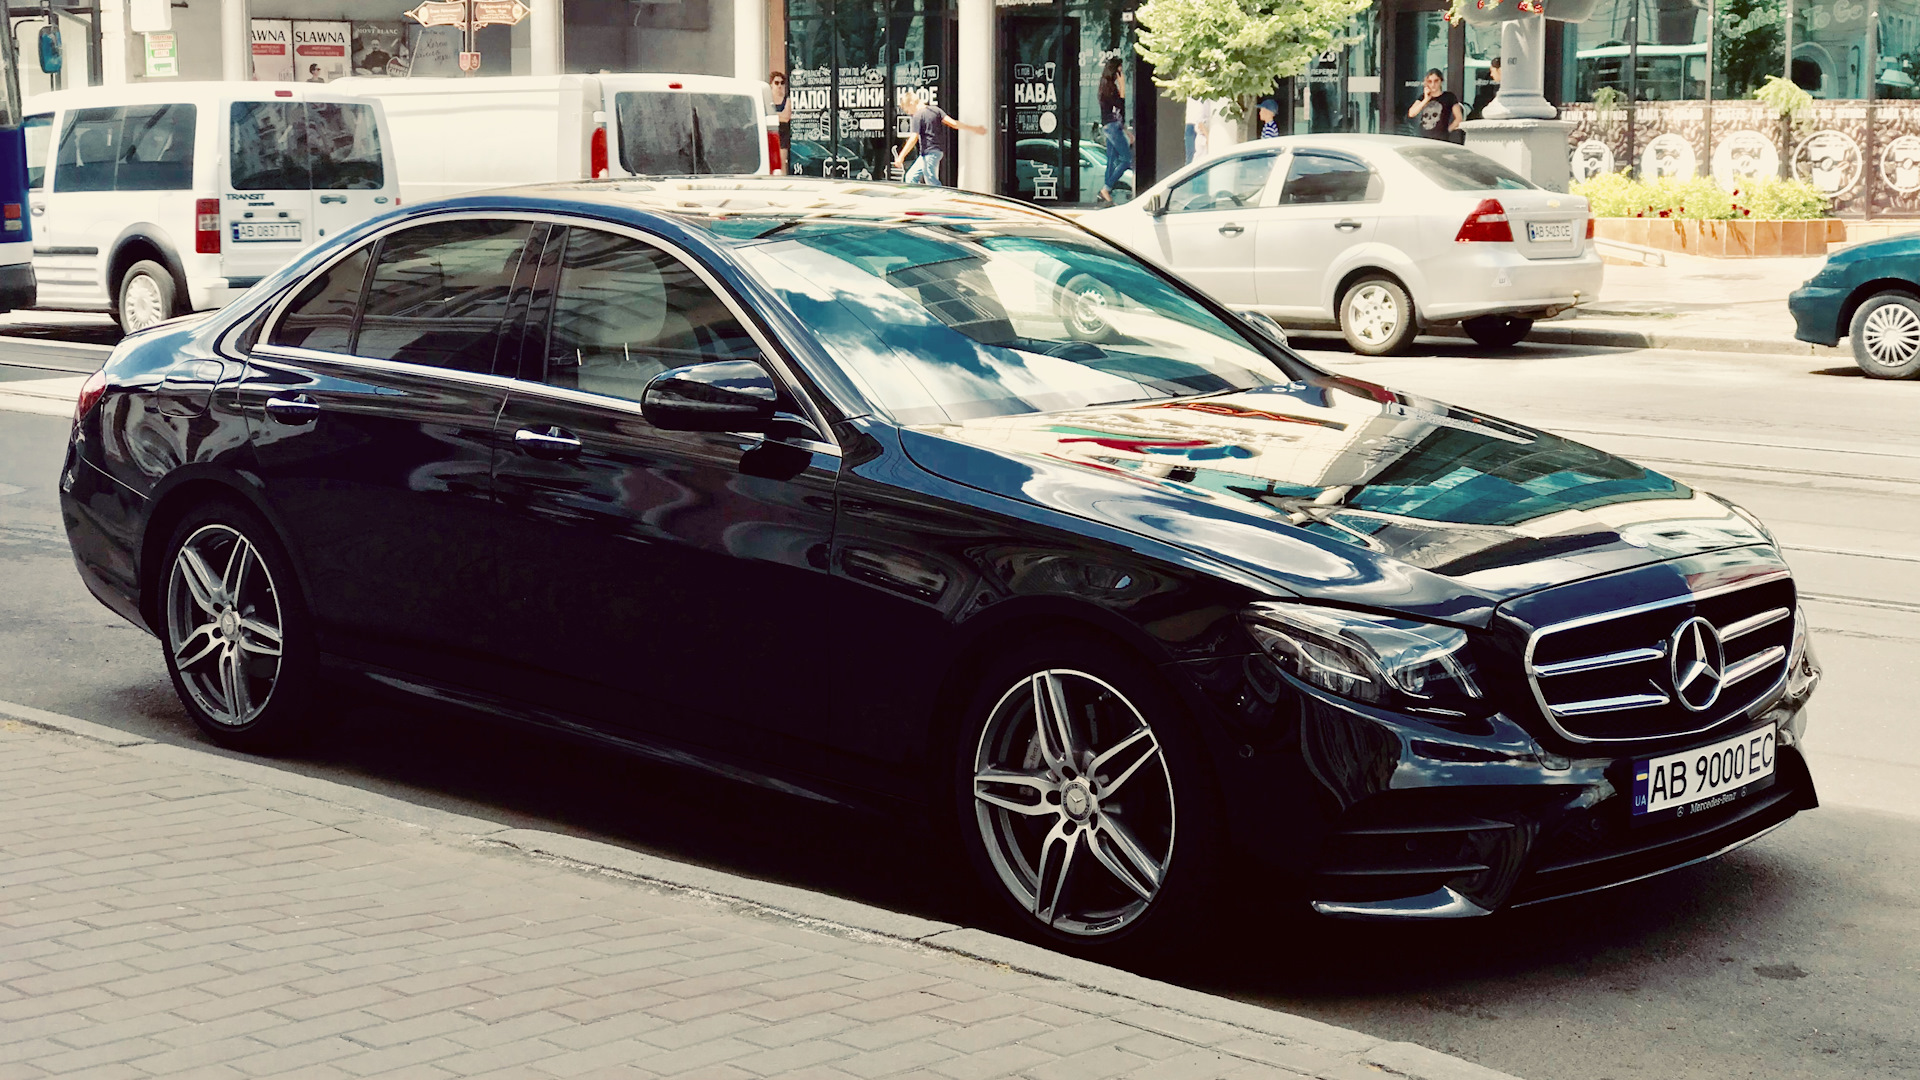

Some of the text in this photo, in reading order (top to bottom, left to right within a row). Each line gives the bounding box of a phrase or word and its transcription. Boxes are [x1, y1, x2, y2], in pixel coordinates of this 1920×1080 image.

[1802, 5, 1830, 31] To
[1833, 0, 1864, 23] Go
[296, 31, 344, 43] SLAWNA
[790, 86, 831, 109] НАПОЇ
[838, 85, 884, 108] КЕЙКИ
[1014, 83, 1056, 103] КАВА
[240, 226, 255, 237] AB
[258, 226, 280, 237] 0837
[1536, 226, 1544, 238] AB
[1650, 732, 1774, 804] AB 9000 EC
[1634, 795, 1646, 806] UA
[1690, 791, 1737, 814] Mercedes-Benz
